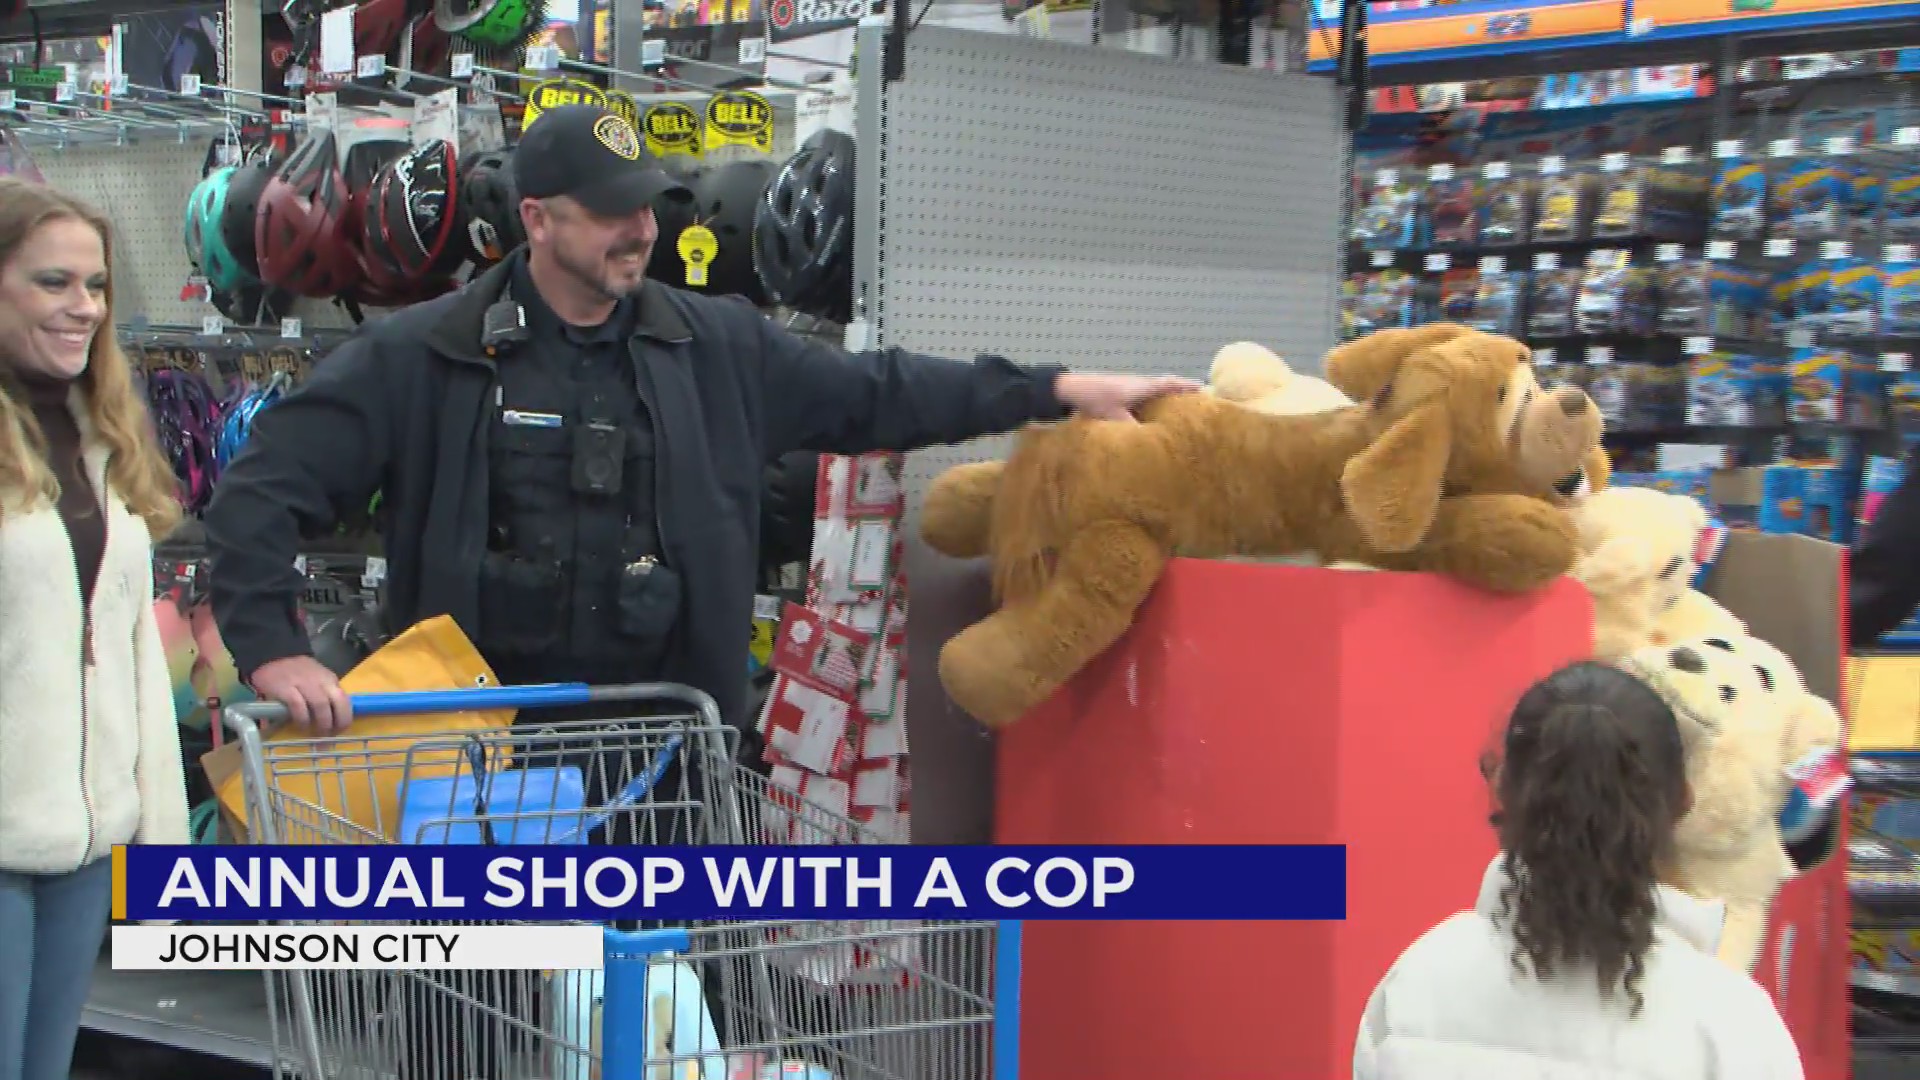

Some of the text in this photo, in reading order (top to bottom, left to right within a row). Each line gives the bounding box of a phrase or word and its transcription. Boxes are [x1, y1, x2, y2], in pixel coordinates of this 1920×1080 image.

[798, 0, 873, 23] Razor
[715, 102, 763, 124] BELL
[651, 114, 691, 135] BELL
